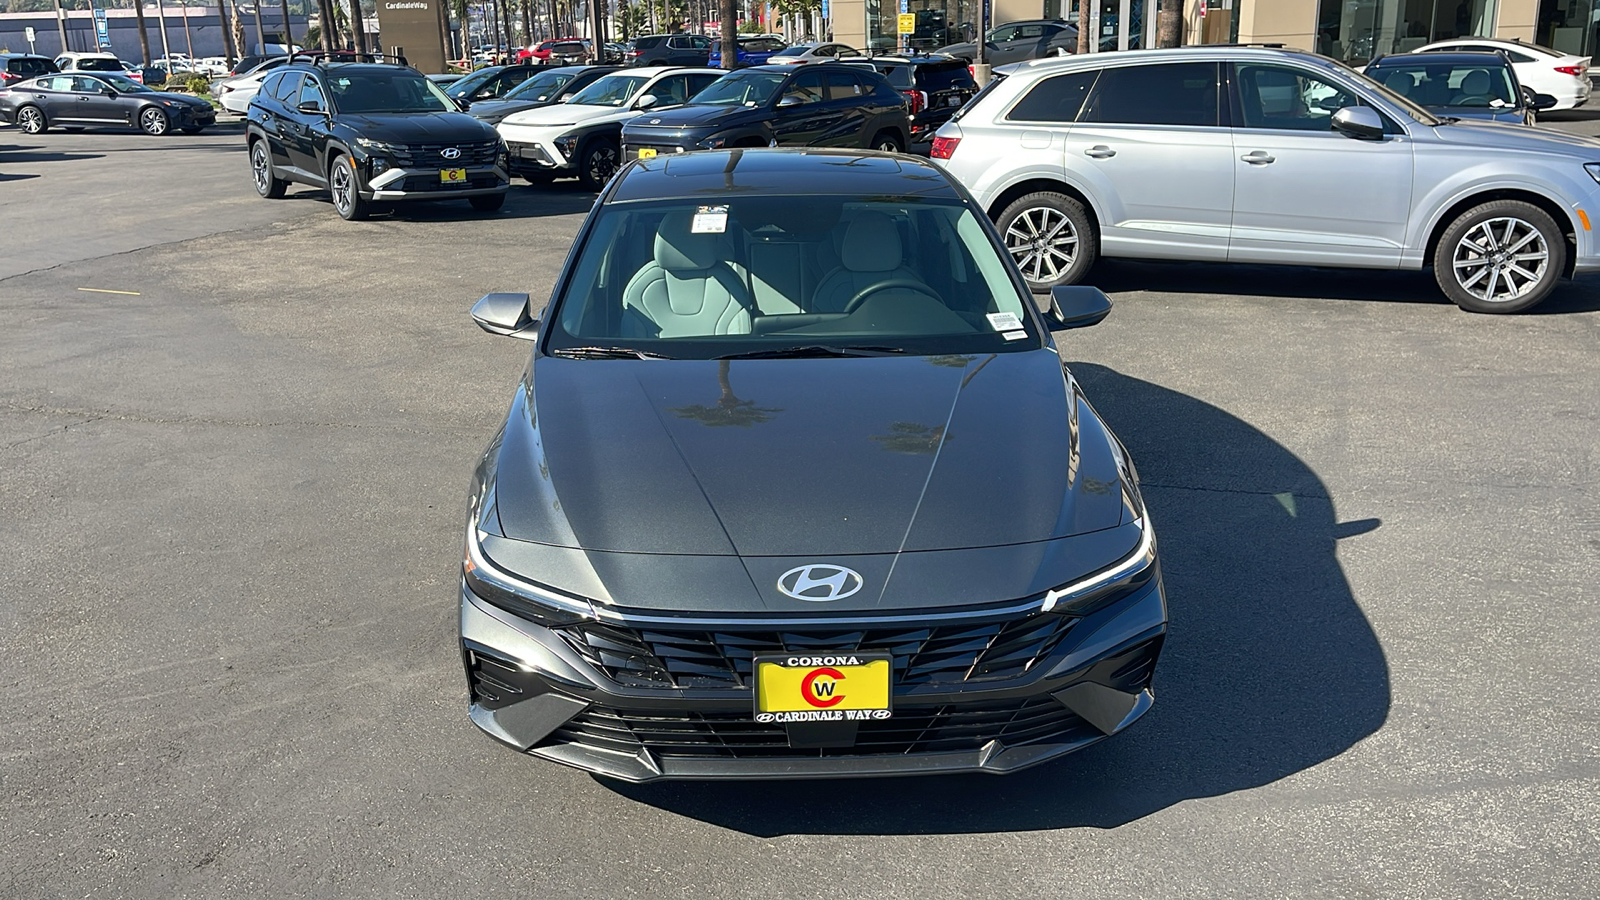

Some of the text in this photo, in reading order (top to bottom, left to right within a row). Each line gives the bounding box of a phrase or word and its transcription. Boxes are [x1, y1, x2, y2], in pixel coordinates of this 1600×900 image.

[787, 656, 859, 666] CORONA
[814, 682, 836, 697] W
[775, 710, 873, 722] CARDINALE WAY
